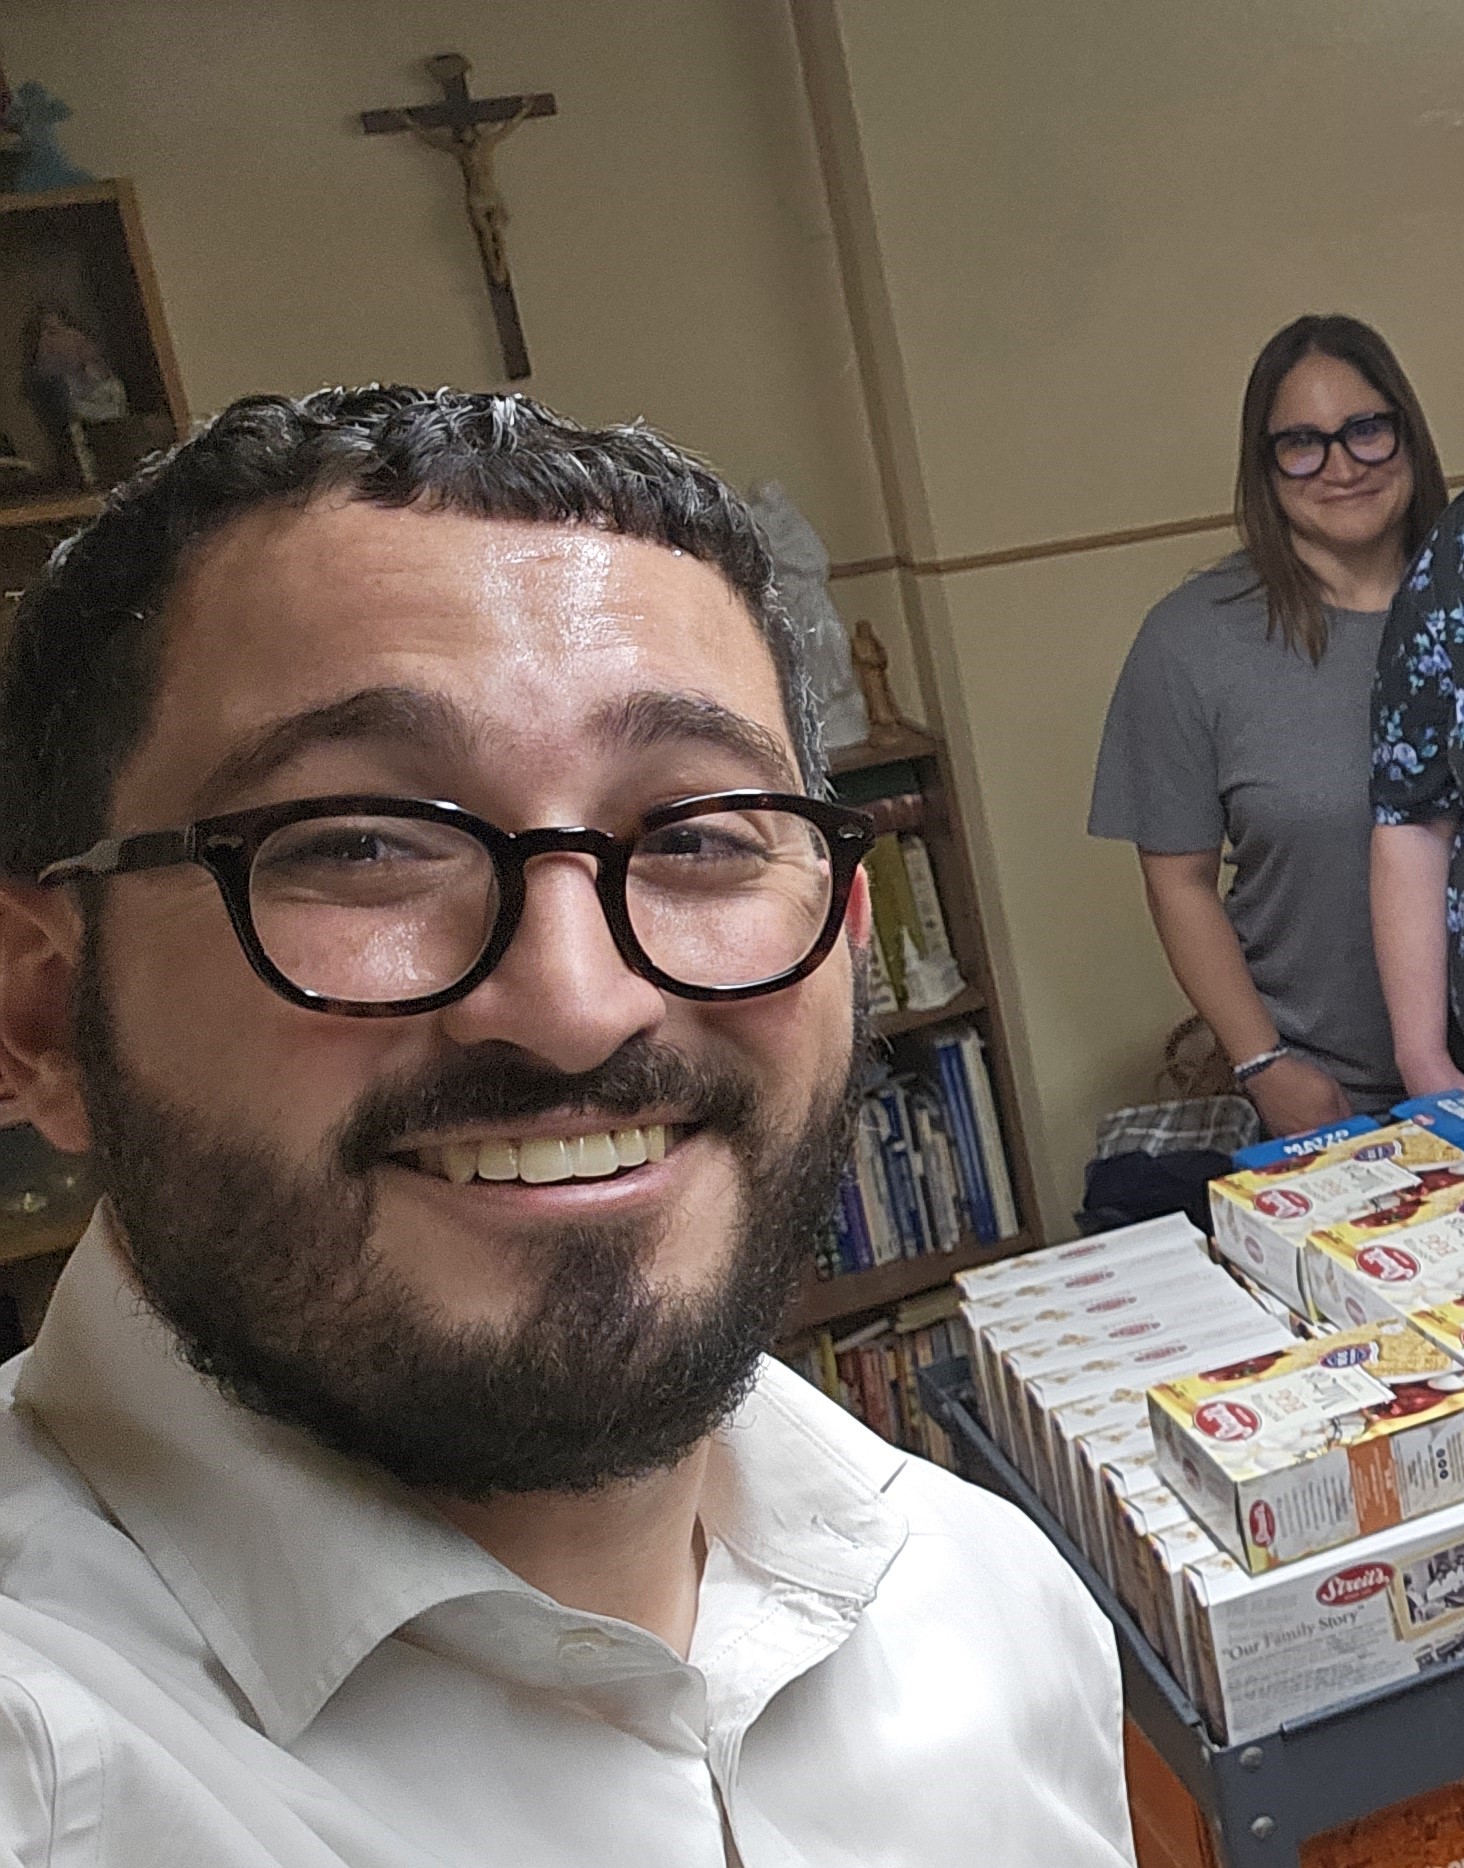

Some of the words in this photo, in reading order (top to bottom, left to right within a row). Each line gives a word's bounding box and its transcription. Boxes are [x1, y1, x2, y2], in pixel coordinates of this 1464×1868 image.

[1222, 1640, 1260, 1661] "Our
[1263, 1621, 1317, 1649] Family
[1317, 1604, 1365, 1630] Story"
